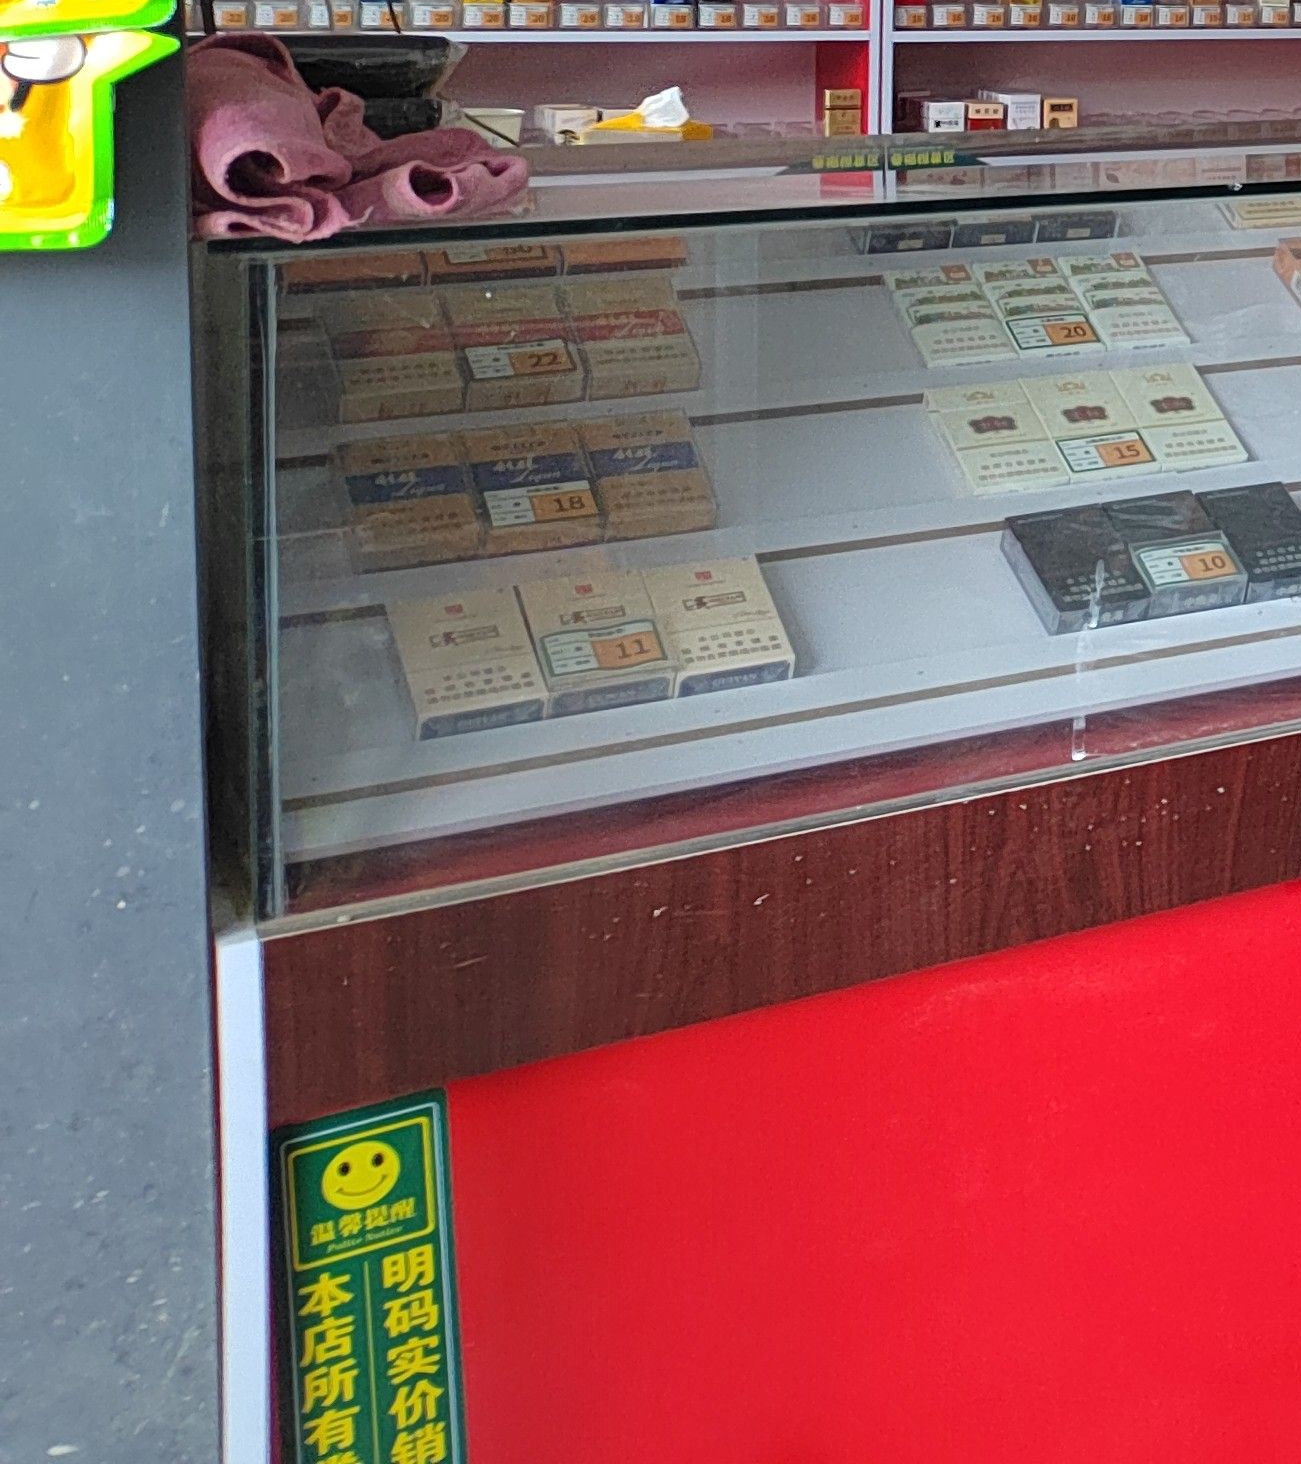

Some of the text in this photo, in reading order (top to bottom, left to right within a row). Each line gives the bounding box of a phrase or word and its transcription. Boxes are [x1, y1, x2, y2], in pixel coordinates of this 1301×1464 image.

[1061, 324, 1087, 339] 20
[529, 351, 563, 368] 22
[1114, 444, 1141, 461] 15
[552, 495, 585, 512] 18
[1198, 555, 1227, 573] 10
[614, 638, 651, 659] 11
[309, 1196, 418, 1247] 温馨提醒
[382, 1243, 449, 1464] 明码实价销
[297, 1271, 362, 1464] 本店所有
